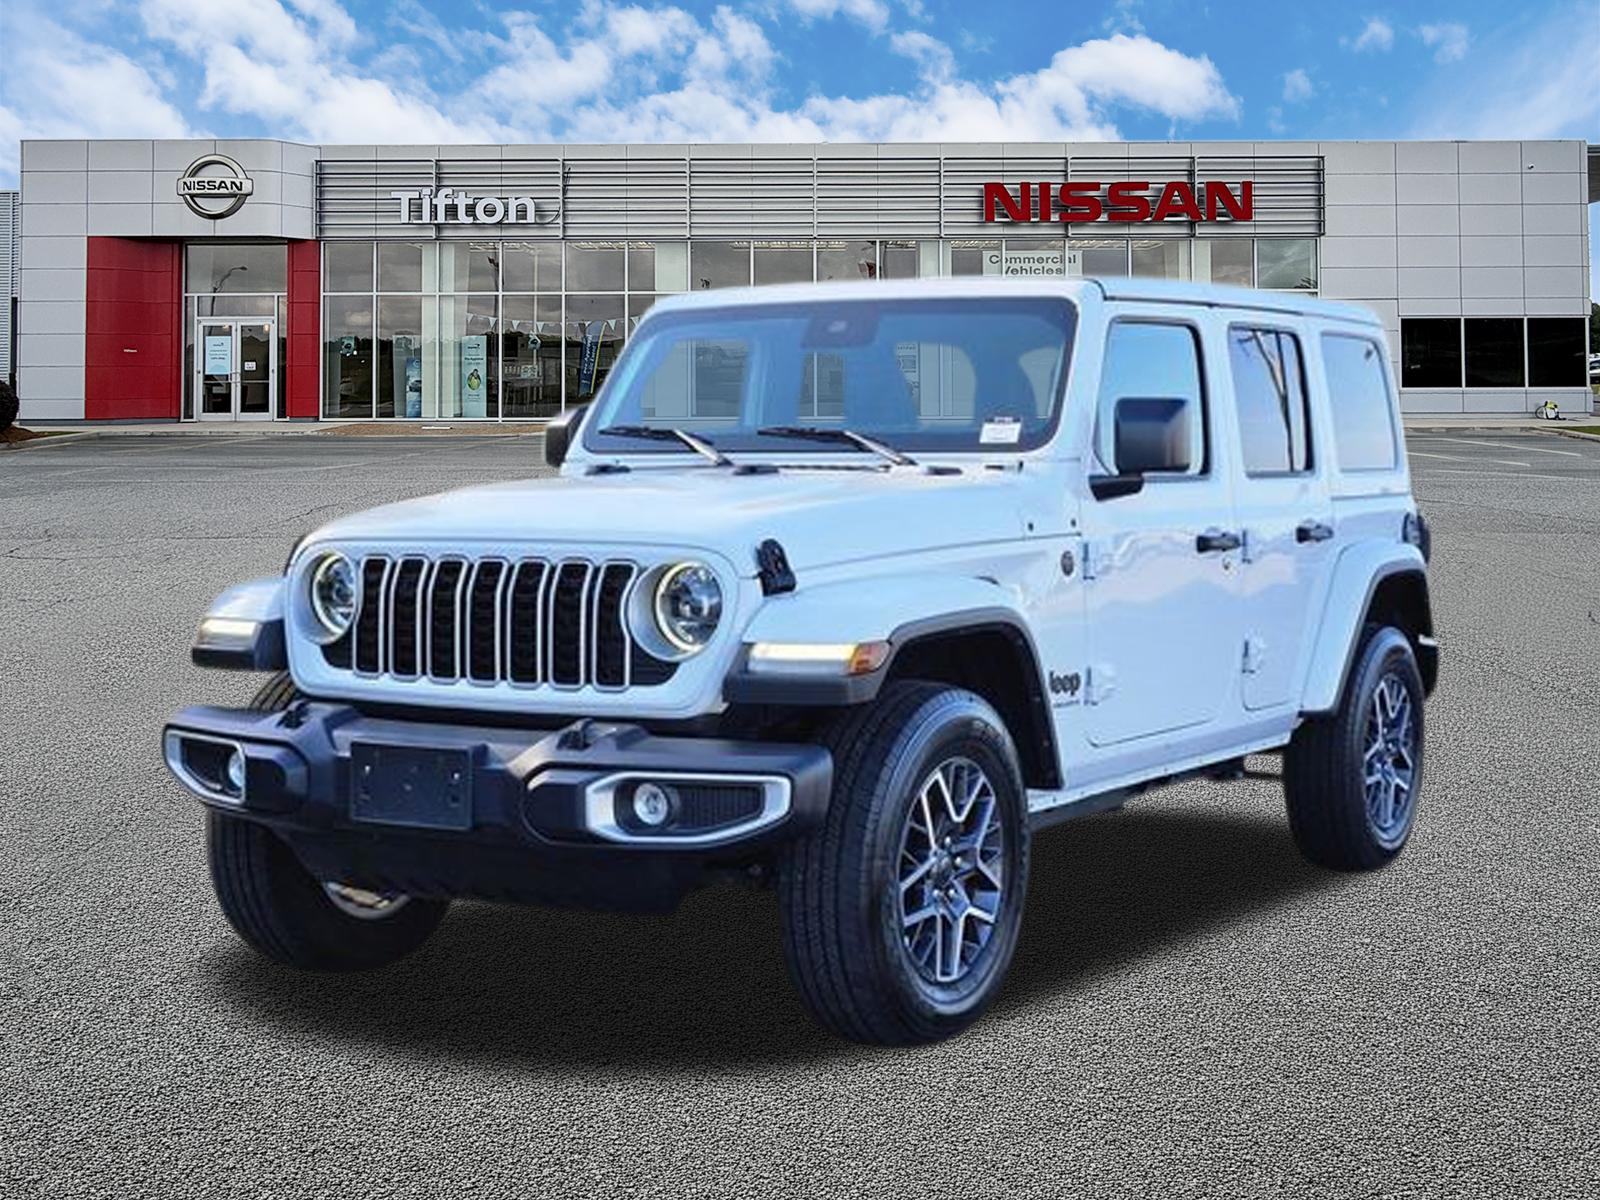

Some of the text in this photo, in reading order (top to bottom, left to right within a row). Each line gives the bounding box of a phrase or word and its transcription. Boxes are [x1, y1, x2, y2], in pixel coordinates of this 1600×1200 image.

[182, 180, 243, 191] NISSAN
[984, 181, 1253, 222] NISSAN
[391, 188, 536, 224] Tifton
